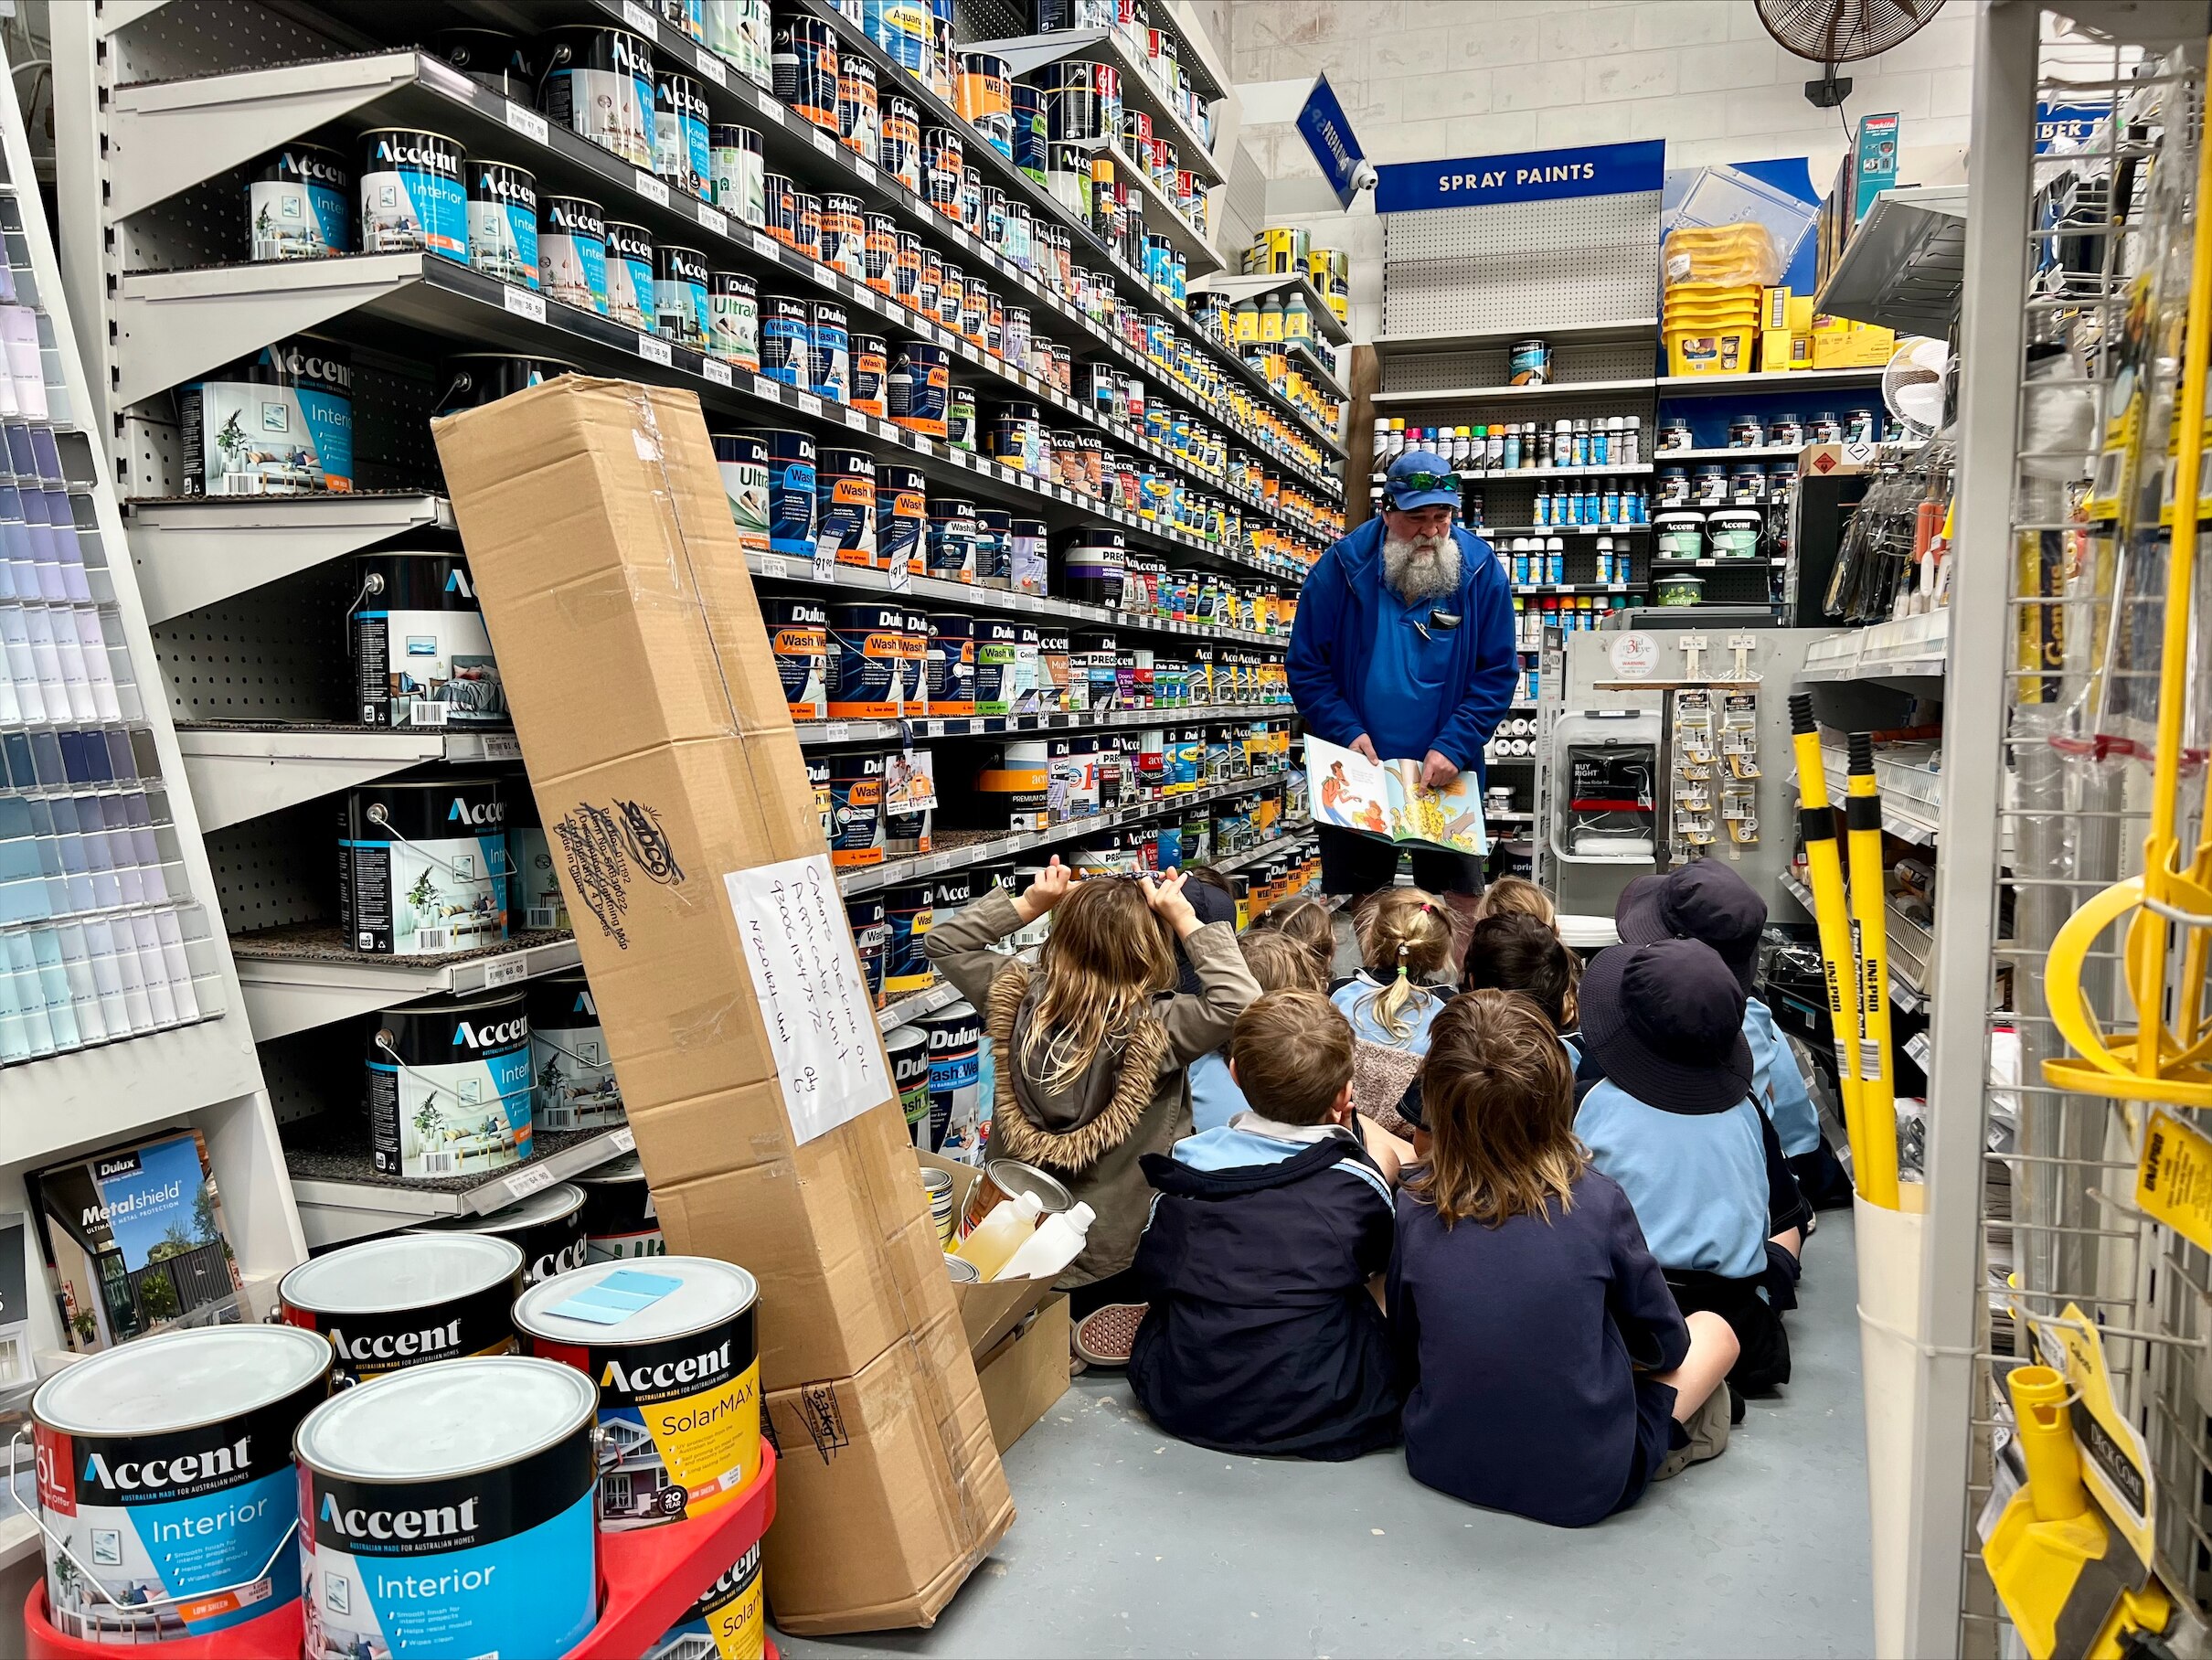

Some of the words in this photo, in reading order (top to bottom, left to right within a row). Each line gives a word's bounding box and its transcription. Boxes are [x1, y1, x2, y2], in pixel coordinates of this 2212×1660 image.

[844, 60, 876, 80] Dulux
[1322, 120, 1350, 172] PREPARING
[377, 141, 458, 174] Accent
[1439, 171, 1506, 193] SPRAY
[1516, 163, 1595, 185] PAINTS
[412, 181, 463, 206] Interior
[828, 198, 859, 213] Dulux
[728, 280, 757, 296] Dulux
[778, 303, 805, 318] Dulux
[818, 306, 847, 325] Dulux
[1666, 522, 1696, 531] Accent
[1721, 520, 1750, 530] Accent
[1013, 794, 1036, 803] PREMIUM
[567, 853, 576, 865] in
[615, 851, 632, 885] 011192
[616, 927, 629, 951] Mop
[833, 953, 857, 1035] DECKING
[856, 1044, 868, 1081] OIL
[930, 1027, 980, 1049] Dulux
[101, 1157, 136, 1177] Dulux
[82, 1181, 180, 1227] Metalshield
[86, 1219, 117, 1236] ULTIMATE
[117, 1213, 139, 1226] METAL
[139, 1200, 180, 1218] PROTECTION
[328, 1318, 462, 1360] Accent
[356, 1361, 385, 1370] AUSTRALIAN
[386, 1359, 400, 1368] MADE
[401, 1357, 412, 1367] FOR
[412, 1352, 442, 1364] AUSTRALIAN
[442, 1348, 460, 1359] HOMES
[601, 1340, 732, 1392] Accent
[635, 1391, 666, 1402] AUSTRALIAN
[666, 1388, 680, 1398] MADE
[680, 1385, 691, 1395] FOR
[690, 1378, 717, 1392] AUSTRALIAN
[717, 1371, 729, 1384] HOMES
[662, 1378, 755, 1437] SolarMAX
[36, 1445, 67, 1494] 6L
[83, 1436, 252, 1491] Accent
[121, 1491, 158, 1503] AUSTRALIAN
[158, 1489, 175, 1499] MADE
[177, 1486, 190, 1496] FOR
[190, 1478, 229, 1494] AUSTRALIAN
[229, 1472, 250, 1485] HOMES
[665, 1491, 682, 1503] 20
[320, 1492, 480, 1540] Accent
[665, 1500, 682, 1510] YEAR
[153, 1495, 268, 1544] Interior
[206, 1546, 236, 1559] projects
[349, 1541, 382, 1552] AUSTRALIAN
[383, 1542, 399, 1553] MADE
[400, 1543, 413, 1552] FOR
[413, 1538, 453, 1552] AUSTRALIAN
[453, 1535, 475, 1548] HOMES
[181, 1563, 204, 1574] Helps
[226, 1549, 249, 1561] mould
[186, 1573, 210, 1584] Wipes
[378, 1565, 496, 1600] Interior
[192, 1605, 207, 1617] LOW
[207, 1600, 229, 1612] SHEEN
[396, 1610, 426, 1619] Smooth
[427, 1607, 449, 1616] finish
[449, 1604, 462, 1613] for
[399, 1615, 427, 1625] interior
[428, 1612, 460, 1623] projects
[403, 1625, 425, 1636] Helps
[425, 1623, 448, 1633] resist
[448, 1619, 473, 1630] mould
[408, 1637, 432, 1647] Wipes
[432, 1634, 455, 1644] clean
